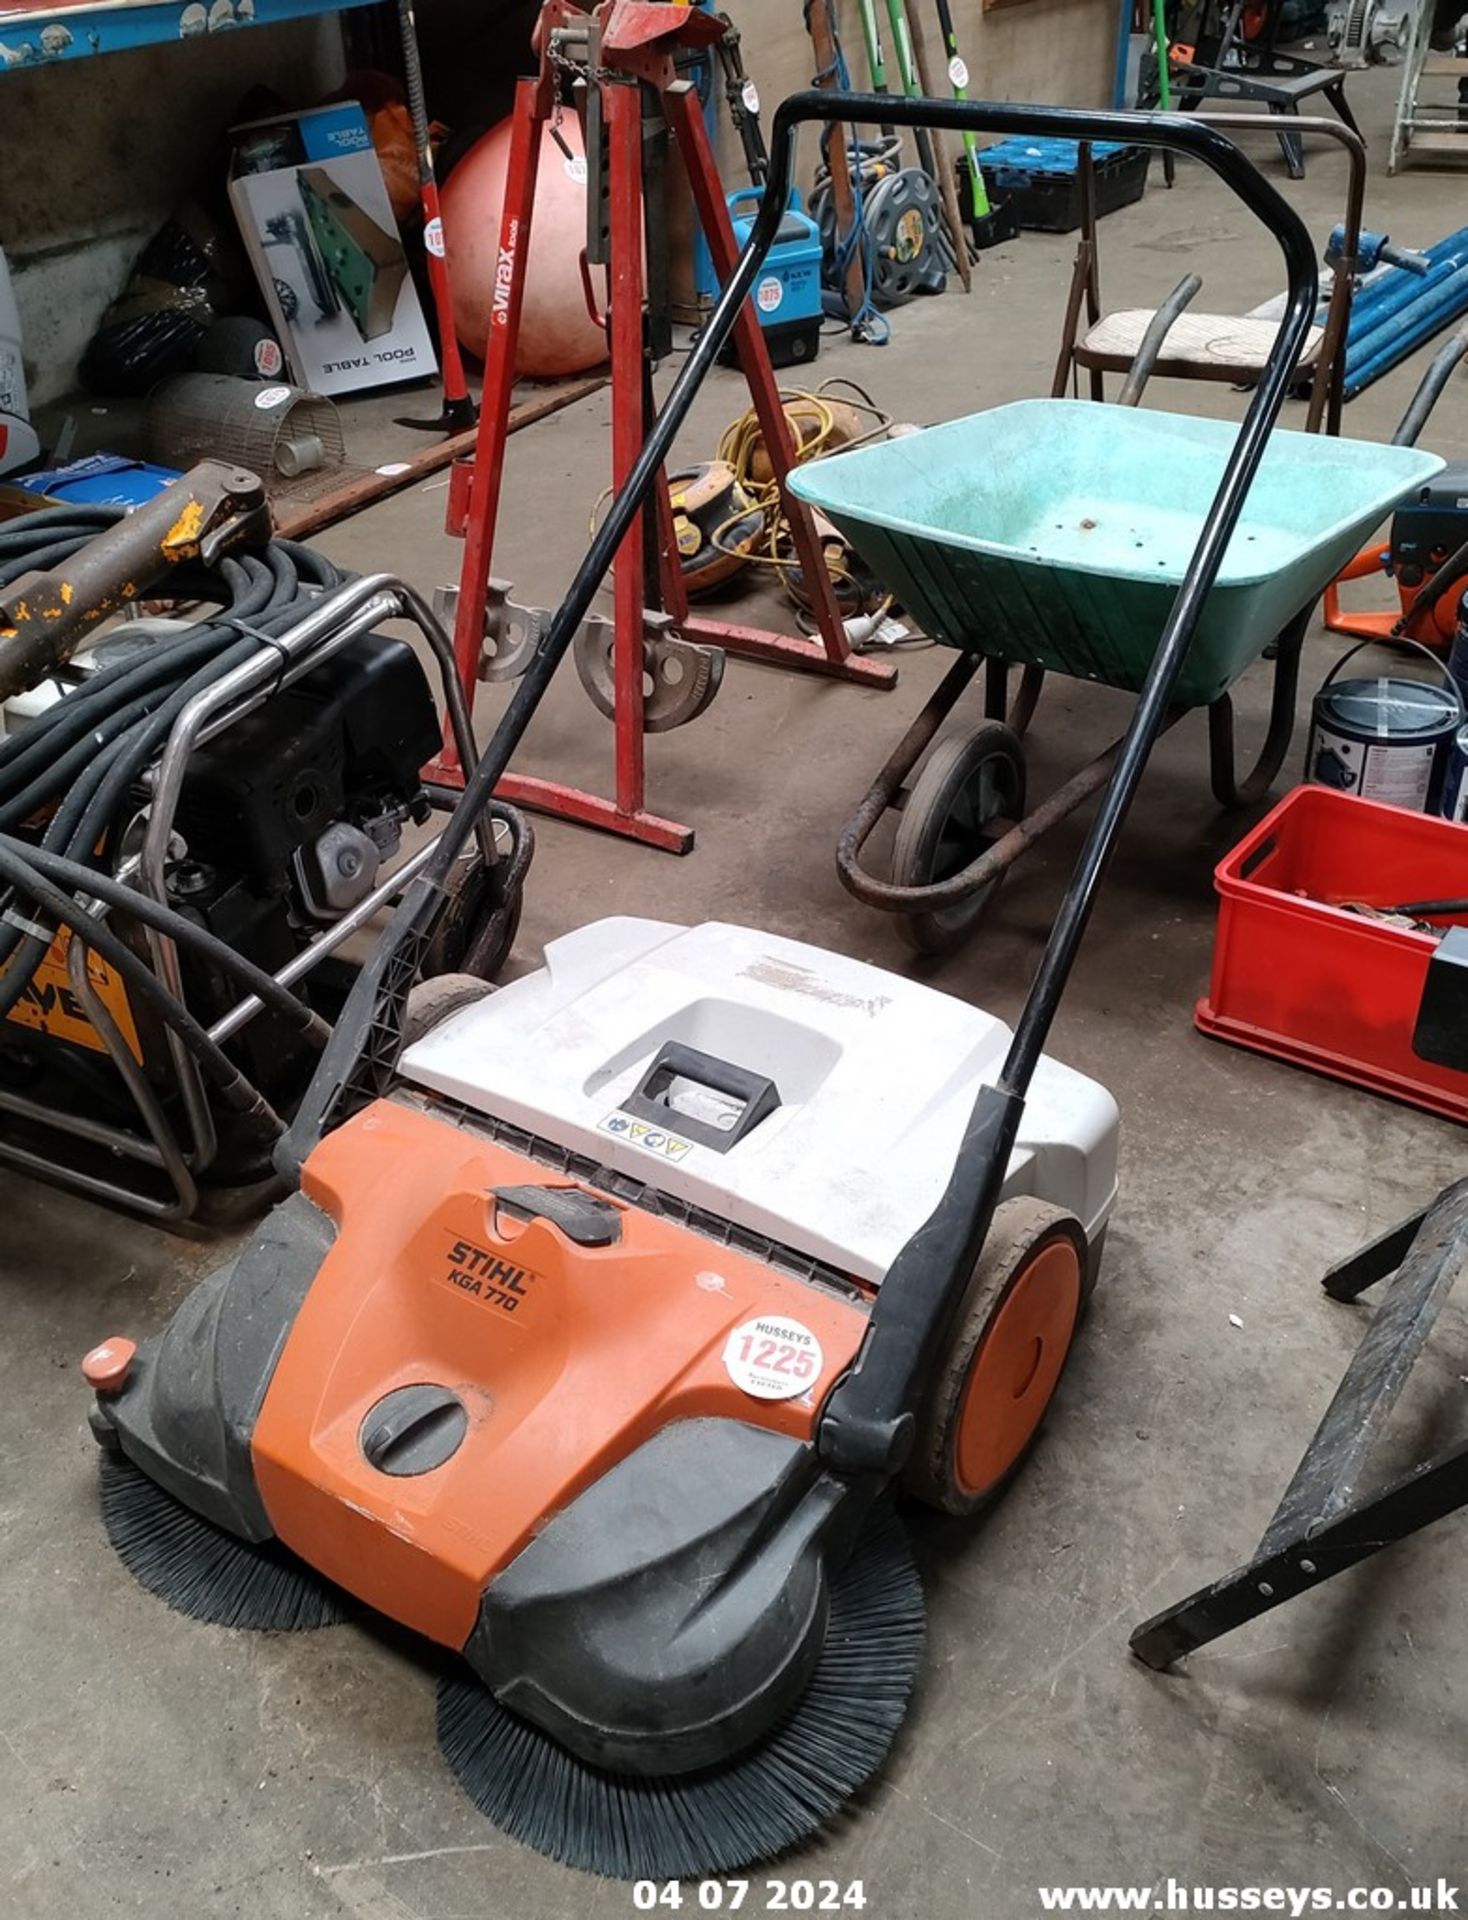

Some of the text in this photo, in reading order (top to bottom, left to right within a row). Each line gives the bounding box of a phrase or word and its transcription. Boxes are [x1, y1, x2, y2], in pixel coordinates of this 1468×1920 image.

[493, 247, 516, 311] virax
[322, 357, 370, 374] TABLE
[373, 346, 415, 362] POOL
[447, 1241, 527, 1296] STIHL
[447, 1268, 519, 1312] KGA 770
[755, 1321, 812, 1346] HUSSEYS
[739, 1334, 817, 1379] 1225
